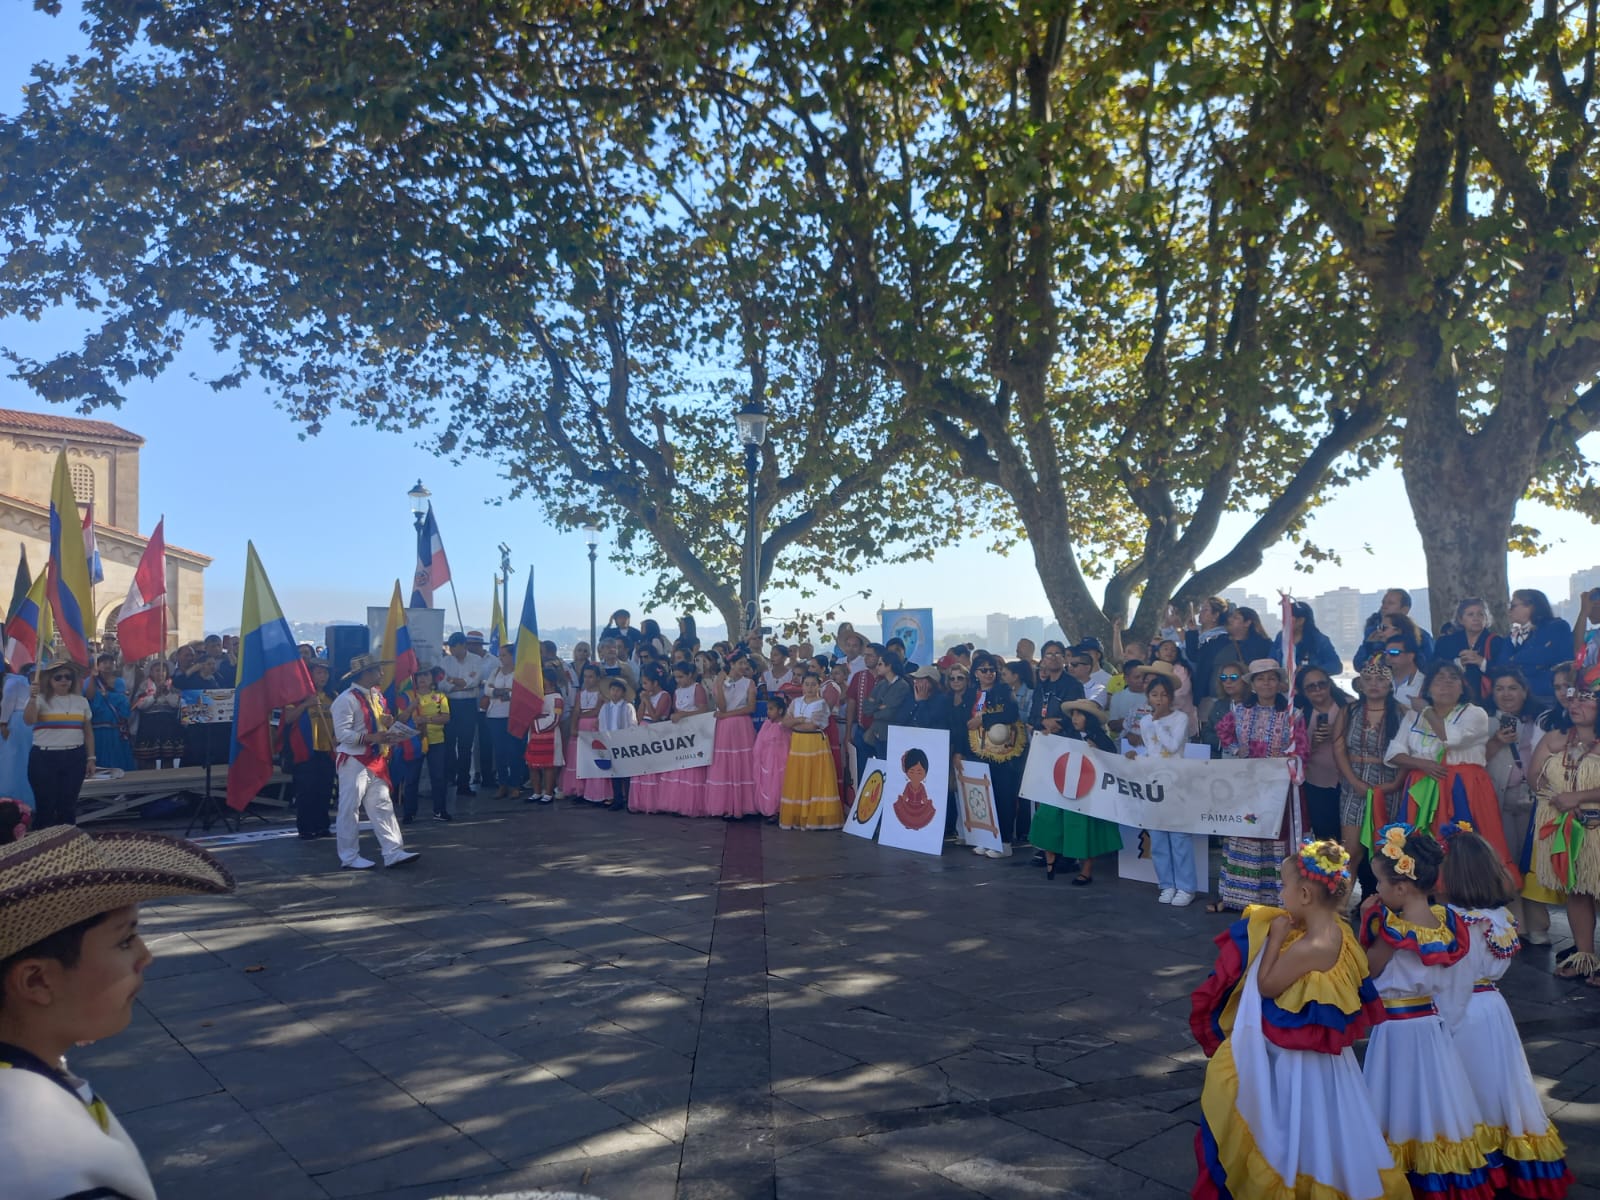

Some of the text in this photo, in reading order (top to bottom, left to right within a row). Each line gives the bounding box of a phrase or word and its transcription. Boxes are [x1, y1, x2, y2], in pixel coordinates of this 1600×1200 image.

[611, 734, 696, 759] PARAGUAY
[1101, 772, 1165, 803] PERÚ
[1201, 814, 1242, 823] FAIMAS
